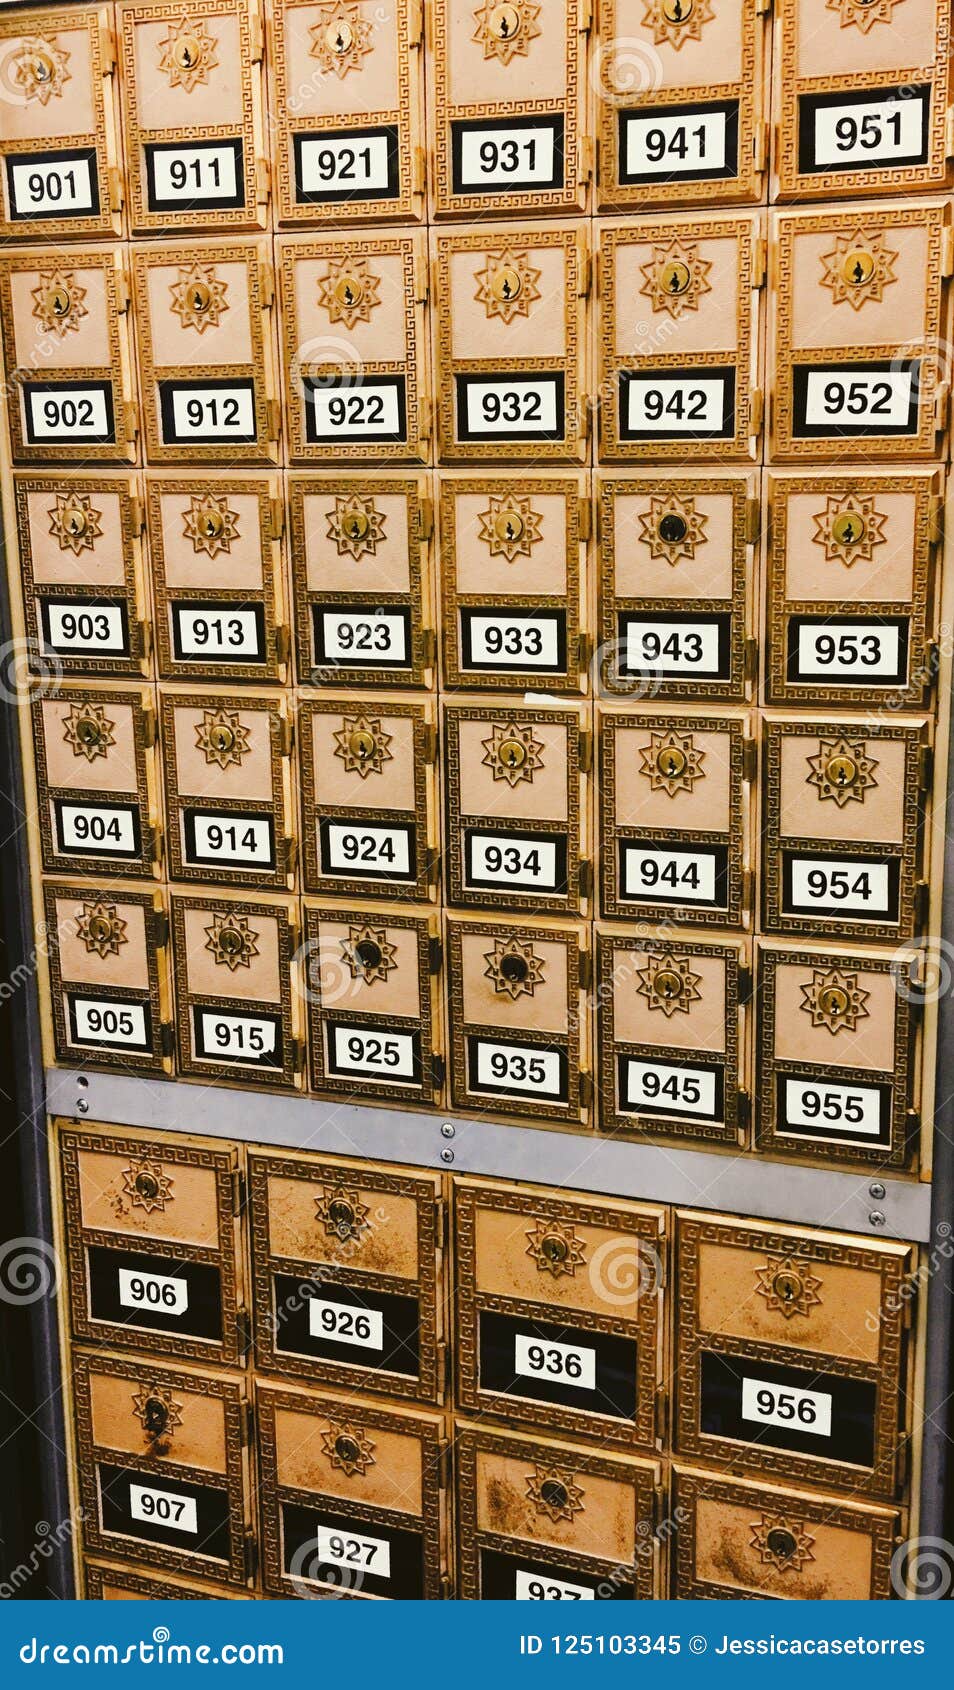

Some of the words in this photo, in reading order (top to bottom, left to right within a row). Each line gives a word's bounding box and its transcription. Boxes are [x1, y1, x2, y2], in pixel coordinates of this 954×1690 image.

[645, 124, 706, 162] 941
[835, 111, 901, 152] 951
[317, 147, 371, 181] 921
[479, 139, 536, 173] 931
[28, 170, 76, 203] 901
[169, 157, 220, 190] 911
[43, 399, 95, 428] 902
[186, 398, 241, 428] 912
[328, 395, 385, 426] 922
[481, 391, 542, 423] 932
[644, 389, 708, 421] 942
[823, 382, 893, 415] 952
[61, 613, 111, 641] 903
[192, 618, 245, 646] 913
[337, 622, 392, 651] 923
[484, 626, 543, 656] 933
[641, 632, 704, 663] 943
[814, 634, 882, 666] 953
[73, 814, 123, 842] 904
[206, 824, 258, 853] 914
[341, 834, 396, 863] 924
[484, 845, 542, 877] 934
[640, 858, 701, 890] 944
[807, 869, 873, 901] 954
[86, 1008, 134, 1036] 905
[214, 1022, 264, 1051] 915
[347, 1036, 400, 1067] 925
[490, 1052, 546, 1084] 935
[641, 1071, 701, 1104] 945
[801, 1090, 864, 1123] 955
[130, 1278, 177, 1307] 906
[321, 1308, 371, 1340] 926
[527, 1345, 582, 1379] 936
[756, 1389, 817, 1424] 956
[140, 1493, 186, 1522] 907
[329, 1536, 378, 1566] 927
